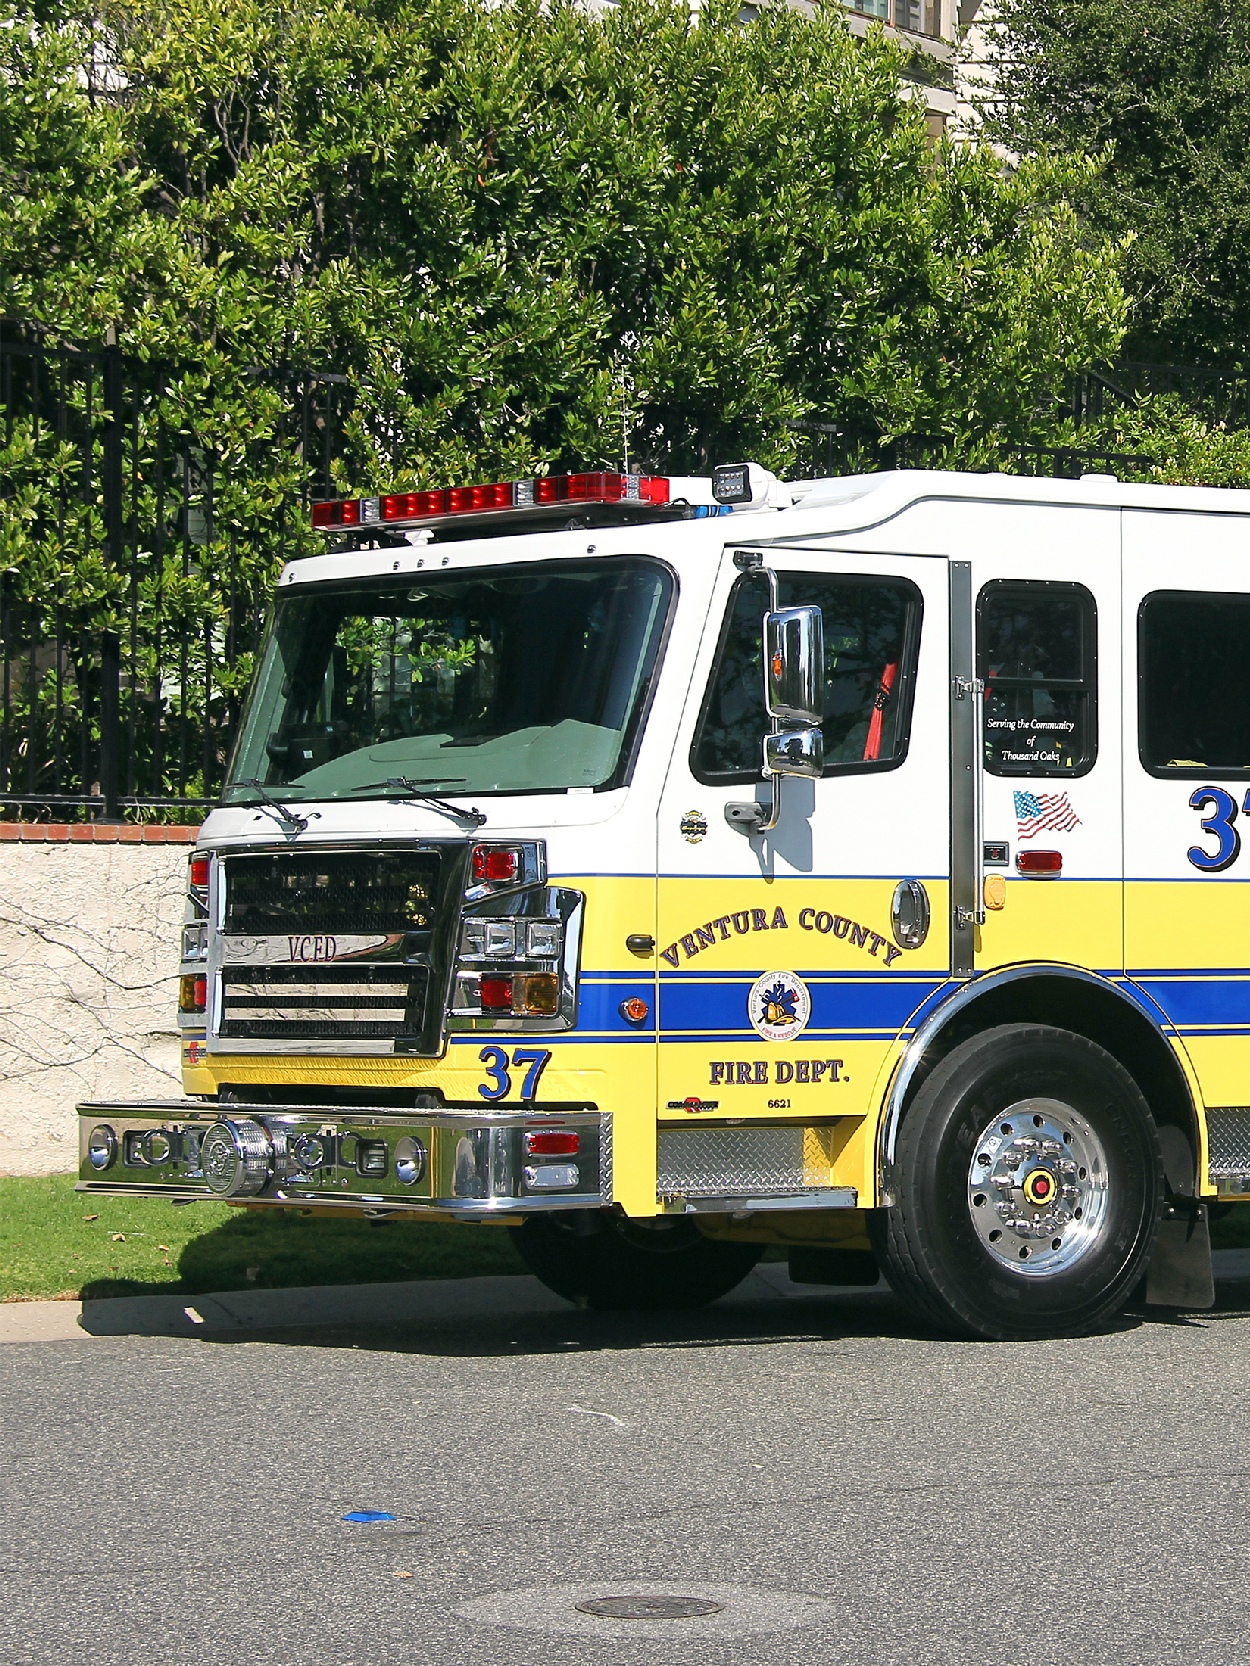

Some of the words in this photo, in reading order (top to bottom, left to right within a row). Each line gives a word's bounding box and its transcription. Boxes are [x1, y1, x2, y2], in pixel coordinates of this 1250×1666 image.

[987, 718, 1016, 731] Serving
[1017, 718, 1029, 729] the
[1030, 719, 1075, 732] Community
[1026, 735, 1037, 747] of
[1001, 750, 1040, 761] Thousand
[1040, 750, 1060, 761] Oaks
[659, 906, 788, 968] VENTURA
[798, 907, 903, 968] COUNTY
[287, 935, 337, 962] VCFD
[478, 1046, 553, 1102] 37
[709, 1061, 768, 1085] FIRE
[774, 1059, 850, 1085] DEPT.
[767, 1099, 791, 1109] 6621
